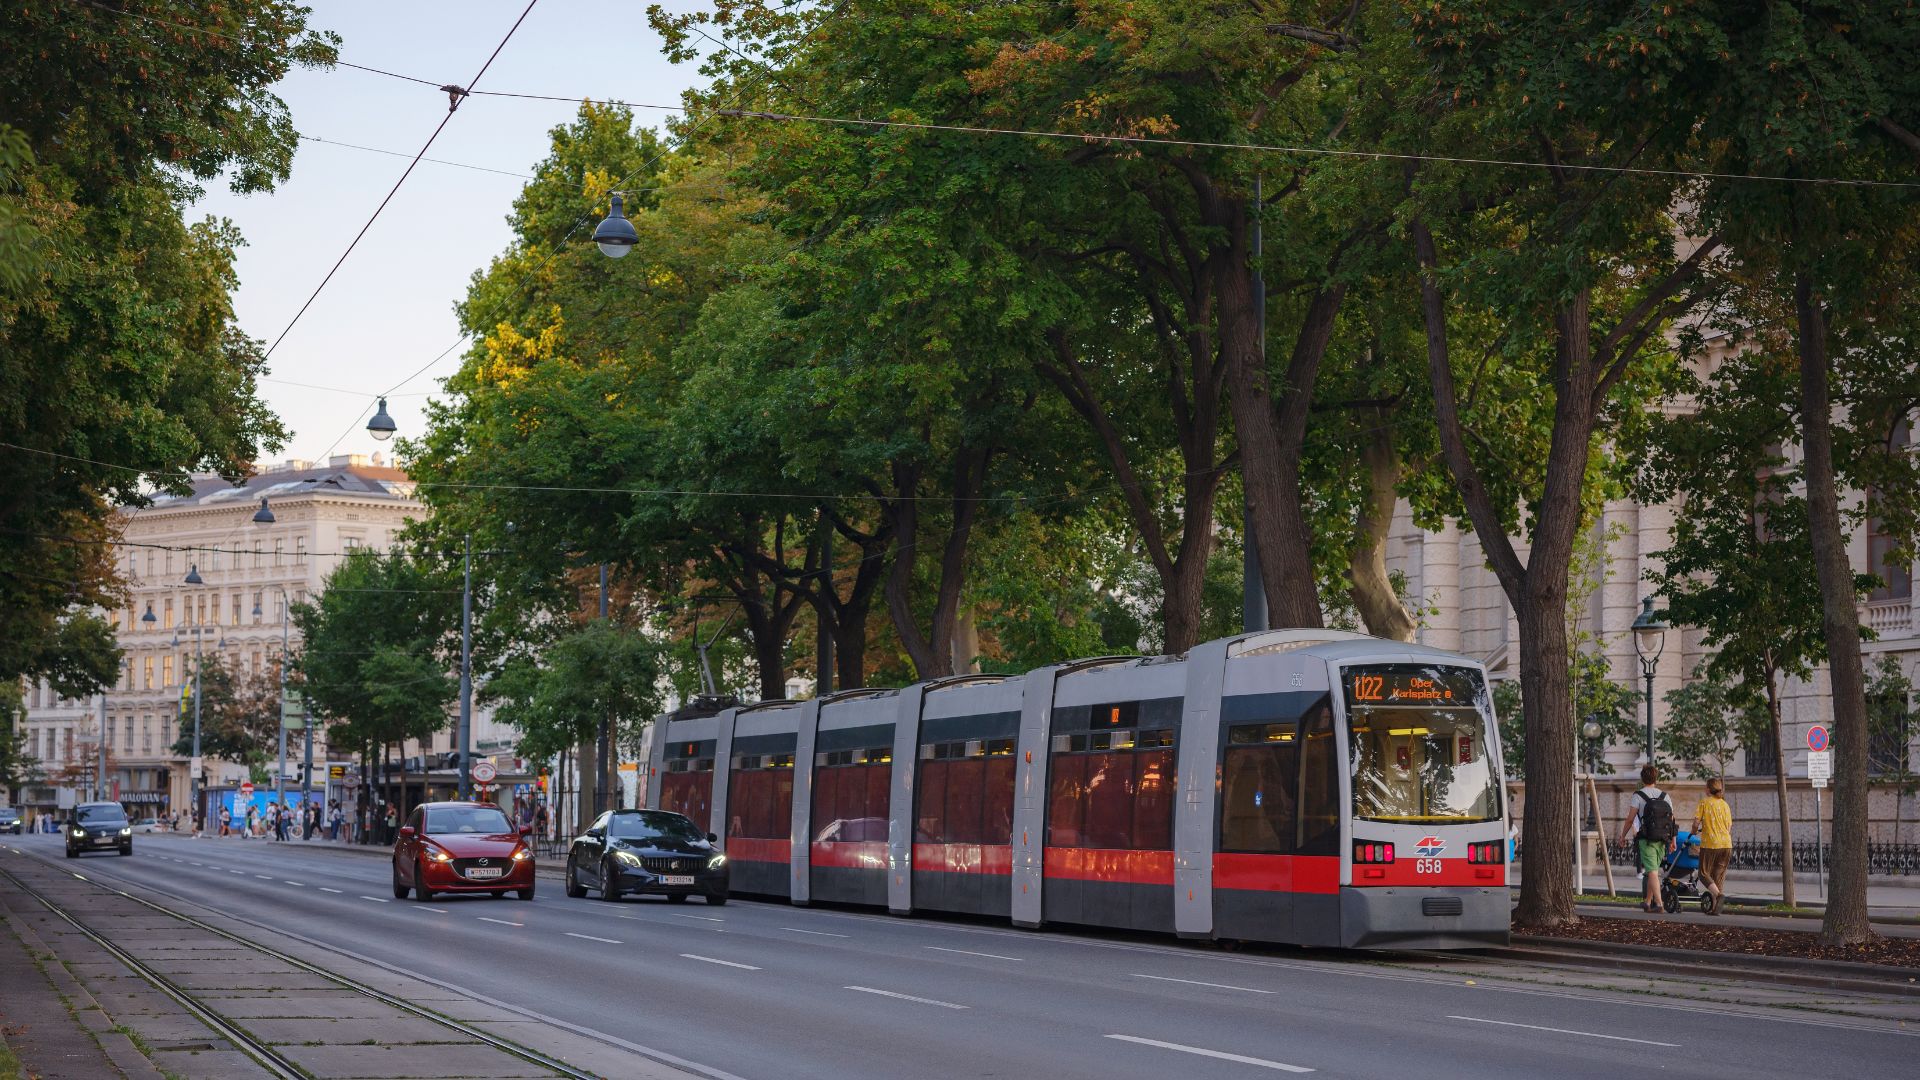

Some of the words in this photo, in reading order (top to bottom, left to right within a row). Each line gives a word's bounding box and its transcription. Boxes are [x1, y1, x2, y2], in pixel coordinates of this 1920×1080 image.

[1410, 678, 1434, 688] Oper
[1392, 688, 1441, 699] Karlsplatz
[120, 793, 160, 803] MALOWAN
[1416, 859, 1442, 874] 658
